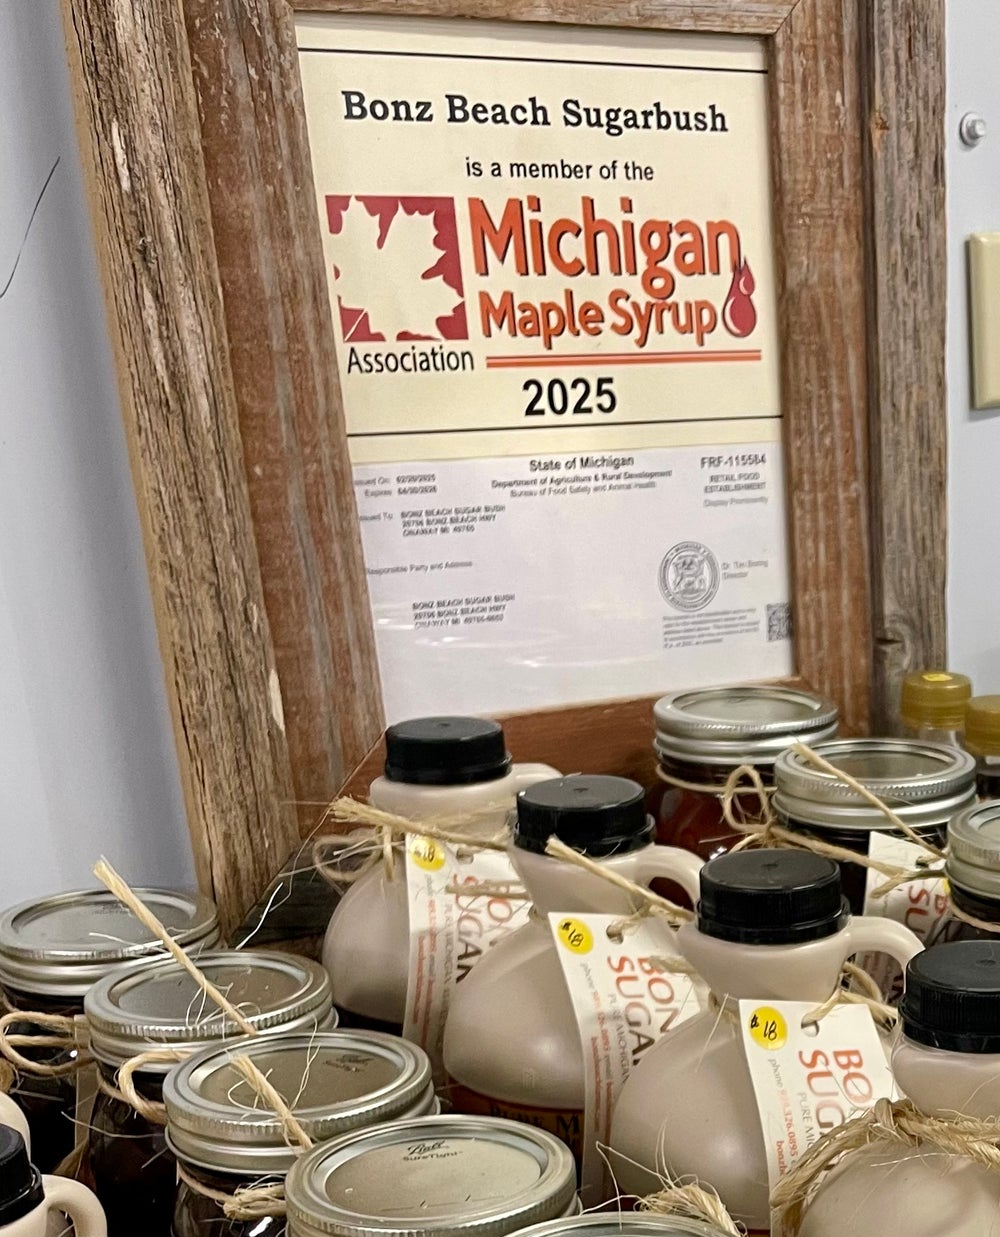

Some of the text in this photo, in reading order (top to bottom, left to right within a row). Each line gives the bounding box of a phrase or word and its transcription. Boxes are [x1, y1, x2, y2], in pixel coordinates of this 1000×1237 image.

[340, 90, 729, 136] Bonz Beach Sugarbush
[465, 156, 655, 181] is a member of the
[466, 195, 741, 299] Michigan
[478, 288, 718, 350] Maple Syrup
[346, 346, 476, 375] Association
[522, 378, 618, 416] 2025
[529, 455, 635, 472] State of Michigan
[607, 954, 656, 1066] SUGA
[767, 1057, 784, 1089] phone
